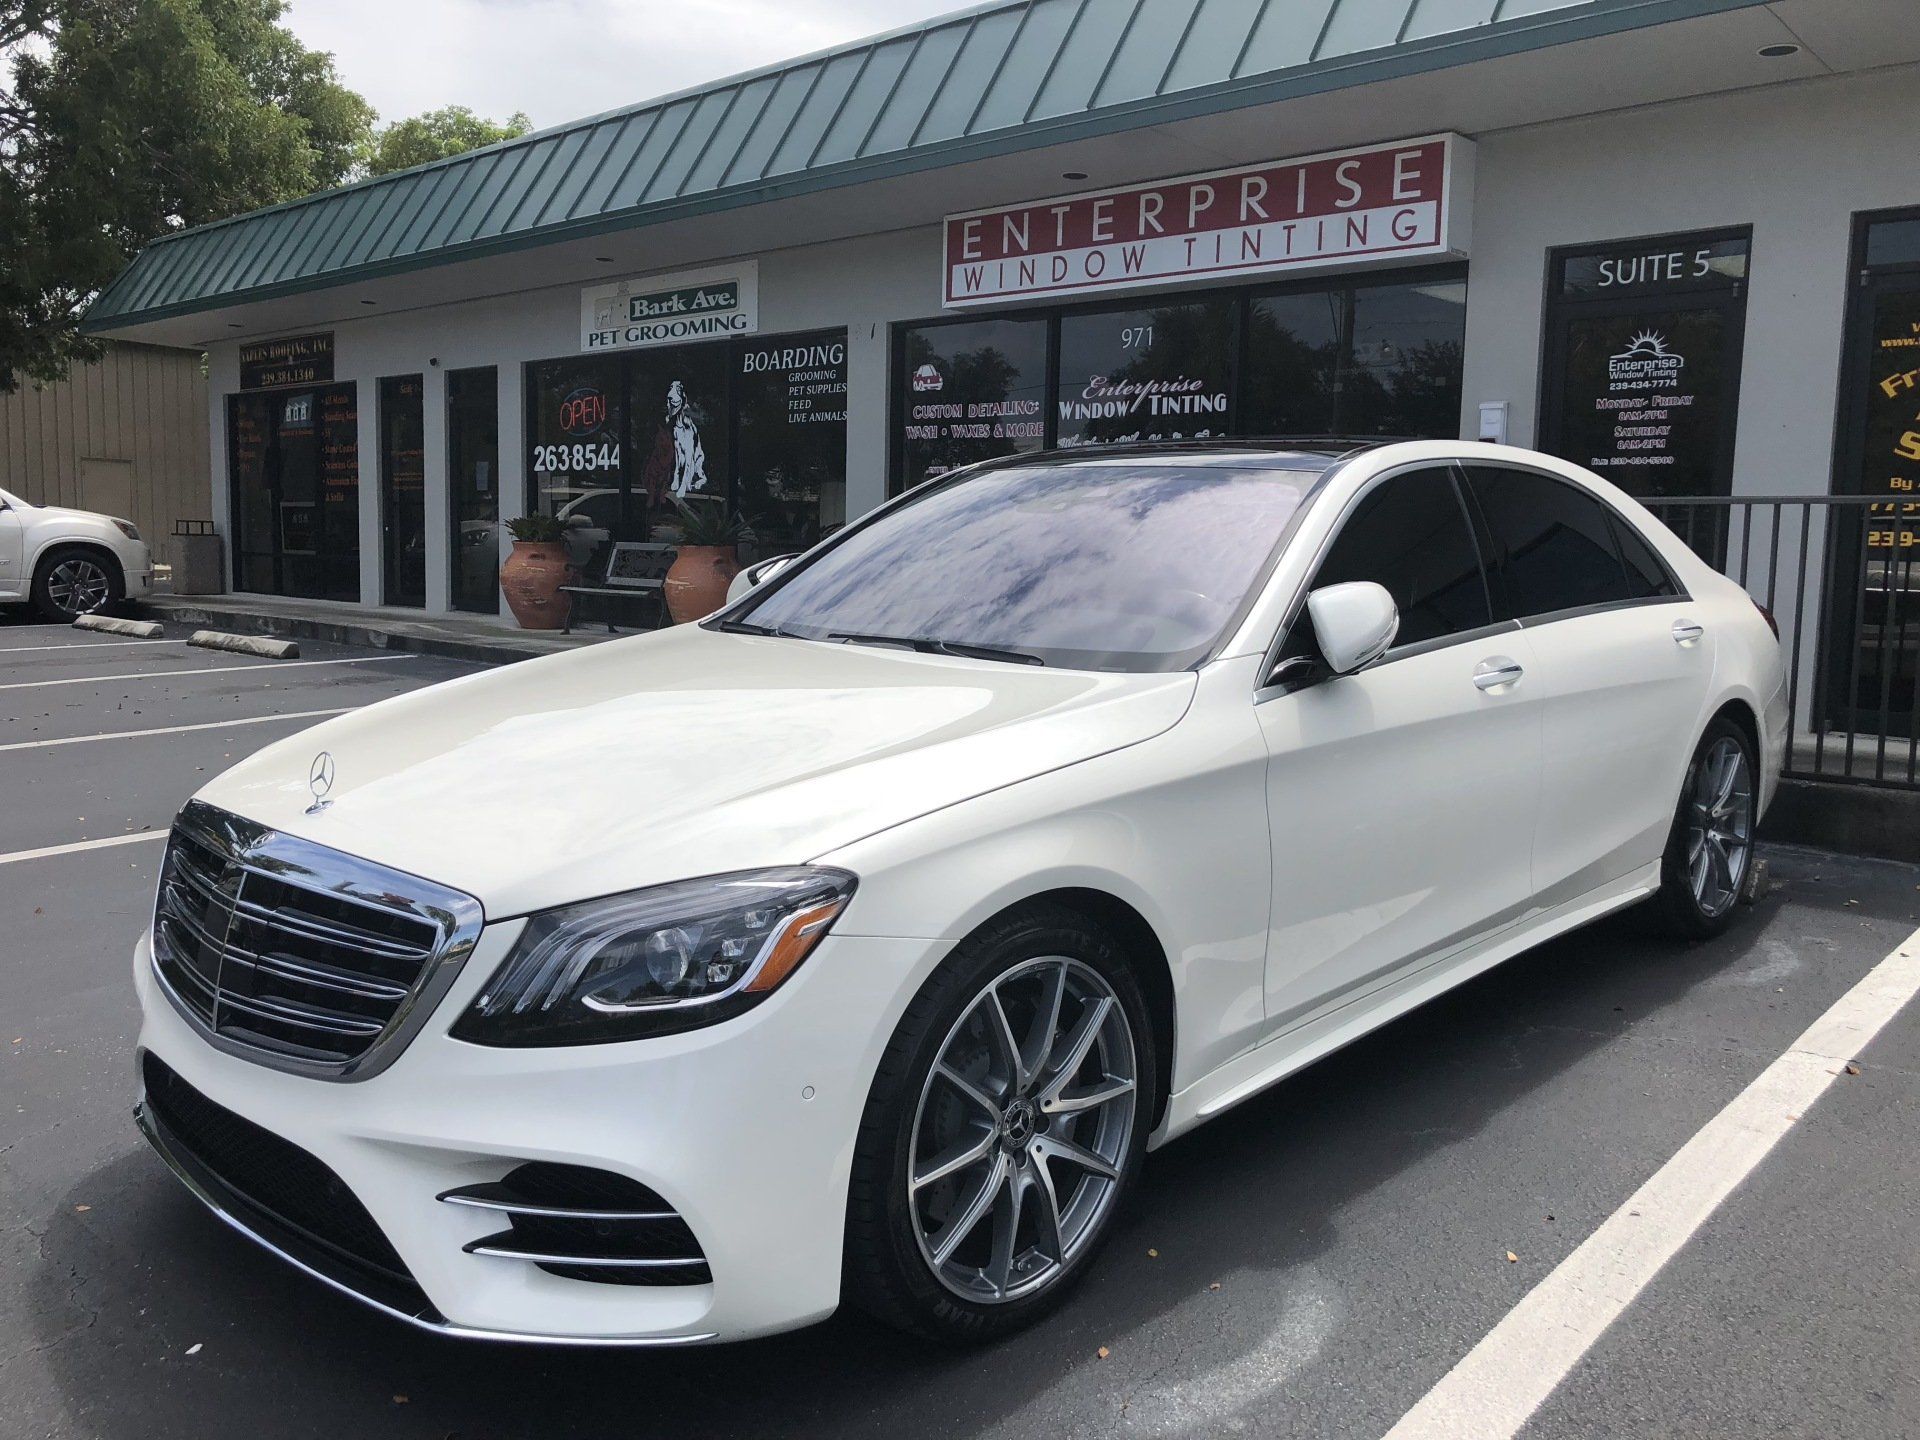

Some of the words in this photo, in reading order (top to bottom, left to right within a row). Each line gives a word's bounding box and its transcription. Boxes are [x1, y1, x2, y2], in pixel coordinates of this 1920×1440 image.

[962, 149, 1425, 260] ENTERPRISE
[963, 243, 1148, 293] WINDOW
[1183, 208, 1419, 267] TINTING
[1598, 252, 1684, 287] SUITE
[1692, 250, 1711, 277] 5
[631, 294, 687, 318] Bark
[689, 290, 736, 311] Ave.
[588, 329, 621, 347] PET
[624, 313, 748, 343] GROOMING
[1121, 326, 1153, 349] 971
[1881, 338, 1920, 347] www.
[742, 343, 845, 374] BOARDING
[1608, 357, 1678, 372] Enterprise
[788, 369, 837, 382] GROOMING
[1608, 370, 1646, 380] Window
[1647, 368, 1678, 378] Tinting
[788, 386, 805, 396] PET
[806, 382, 848, 395] SUPPLIES
[1081, 374, 1204, 413] Enterprise
[1608, 379, 1678, 391] 239-434-7774
[788, 399, 812, 410] FEED
[1058, 400, 1131, 421] WINDOW
[1148, 392, 1228, 416] TINTING
[1651, 395, 1695, 407] FRIDAY
[560, 394, 606, 430] OPEN
[788, 413, 808, 423] LIVE
[809, 410, 848, 422] ANIMALS
[912, 403, 963, 419] CUSTOM
[905, 425, 938, 440] WASH
[950, 423, 990, 440] WAXES
[993, 424, 1004, 439] &
[1006, 421, 1045, 438] MORE
[1613, 425, 1671, 438] SATURDAY
[533, 443, 620, 472] 263-8544
[1889, 477, 1913, 491] By
